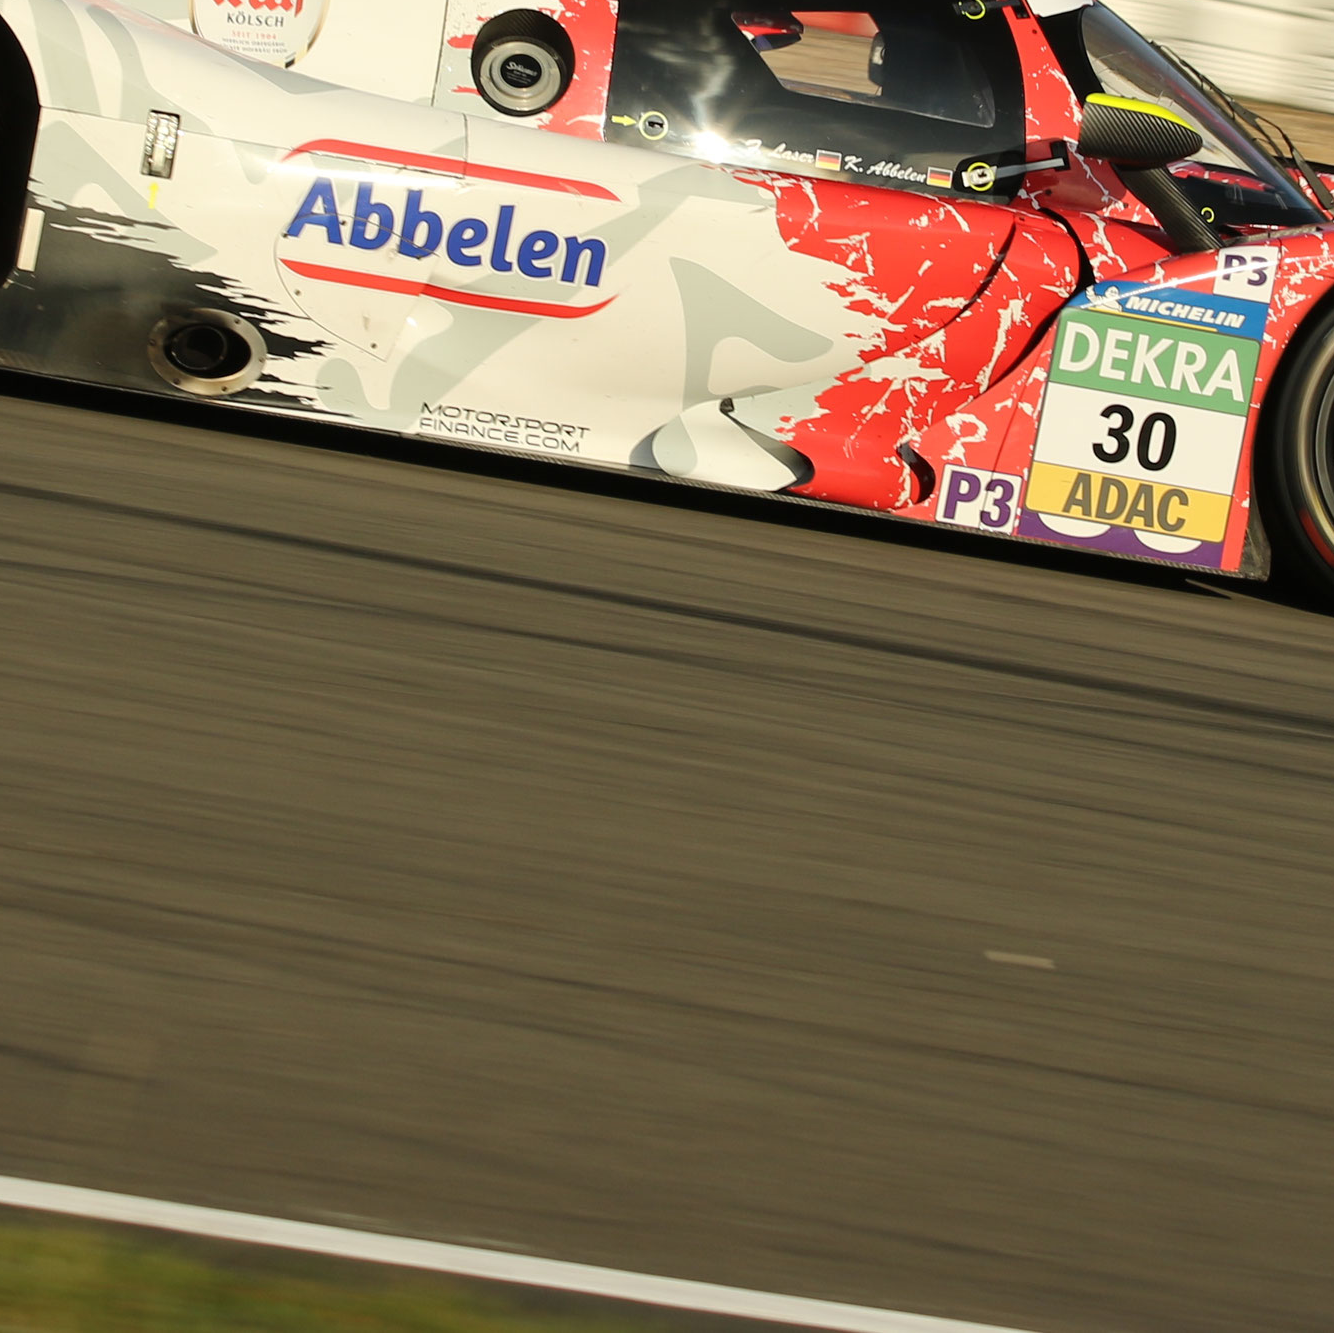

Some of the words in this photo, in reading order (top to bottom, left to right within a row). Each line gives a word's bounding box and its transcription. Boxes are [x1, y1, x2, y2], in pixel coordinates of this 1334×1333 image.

[226, 10, 284, 27] KÖLSCH
[768, 142, 815, 163] Laser
[844, 155, 865, 174] K.
[866, 161, 927, 184] Abbelen
[287, 176, 607, 288] Abbelen
[1222, 254, 1268, 286] P3
[1125, 295, 1246, 329] MICHELIN
[1058, 321, 1245, 403] DEKRA
[419, 416, 581, 454] FINANCE.COM
[420, 401, 591, 439] MOTORSPORT
[1092, 404, 1177, 471] 30
[942, 469, 1014, 528] P3
[1062, 472, 1189, 533] ADAC
